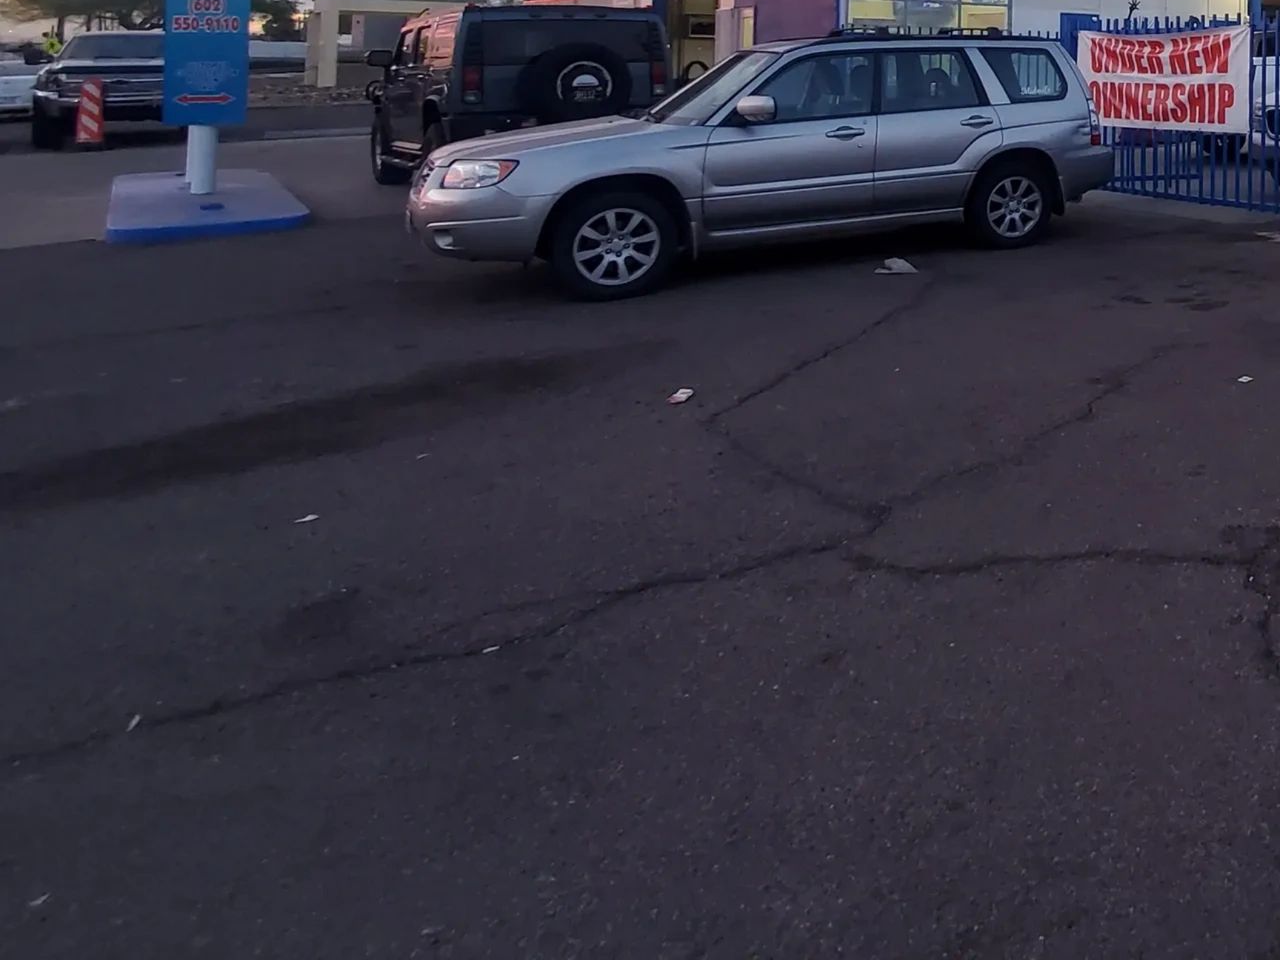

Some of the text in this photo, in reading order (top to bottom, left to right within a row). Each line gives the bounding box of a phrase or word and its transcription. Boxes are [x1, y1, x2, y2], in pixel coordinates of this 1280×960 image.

[172, 15, 240, 33] 550-9110
[1090, 34, 1232, 74] UNDER NEW
[1089, 80, 1235, 125] OWNERSHIP
